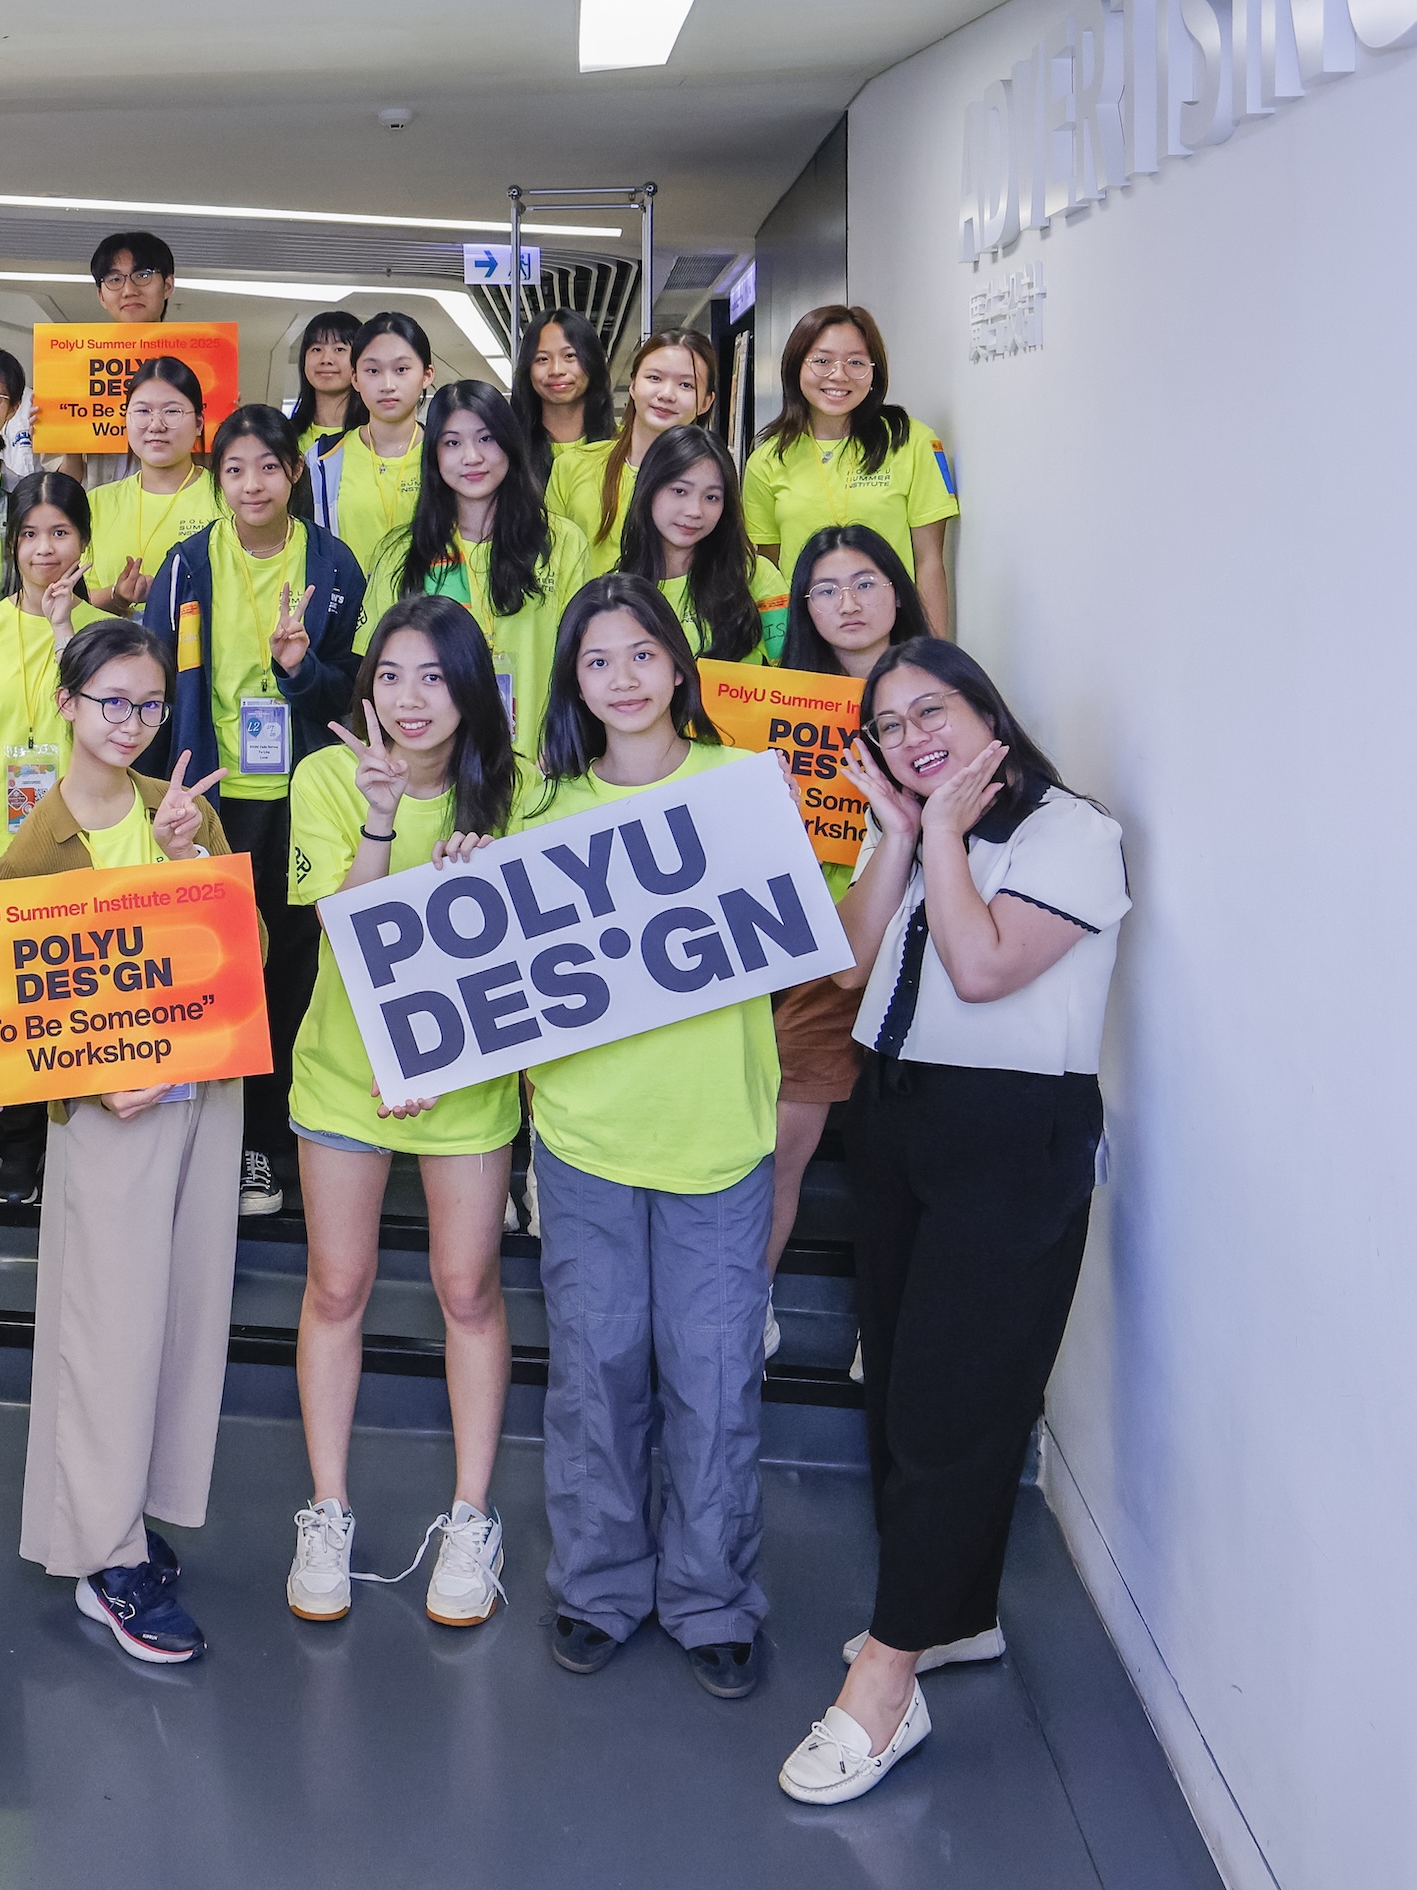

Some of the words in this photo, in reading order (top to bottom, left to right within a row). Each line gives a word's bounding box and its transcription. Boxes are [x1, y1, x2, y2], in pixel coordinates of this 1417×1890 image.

[958, 0, 1417, 263] ADVERTIS
[50, 338, 85, 352] PolyU
[87, 338, 137, 350] Summer
[139, 338, 187, 350] Institute
[190, 338, 221, 349] 2025
[92, 403, 115, 417] Be
[717, 683, 766, 703] PolyU
[769, 689, 842, 714] Summer
[247, 721, 261, 732] L2
[768, 717, 860, 752] POLY
[6, 900, 88, 924] Summer
[93, 890, 171, 915] Institute
[176, 882, 226, 903] 2025
[349, 803, 707, 989] POLYU
[12, 925, 145, 969] POLYU
[25, 1015, 63, 1040] Be
[26, 1037, 172, 1073] Workshop
